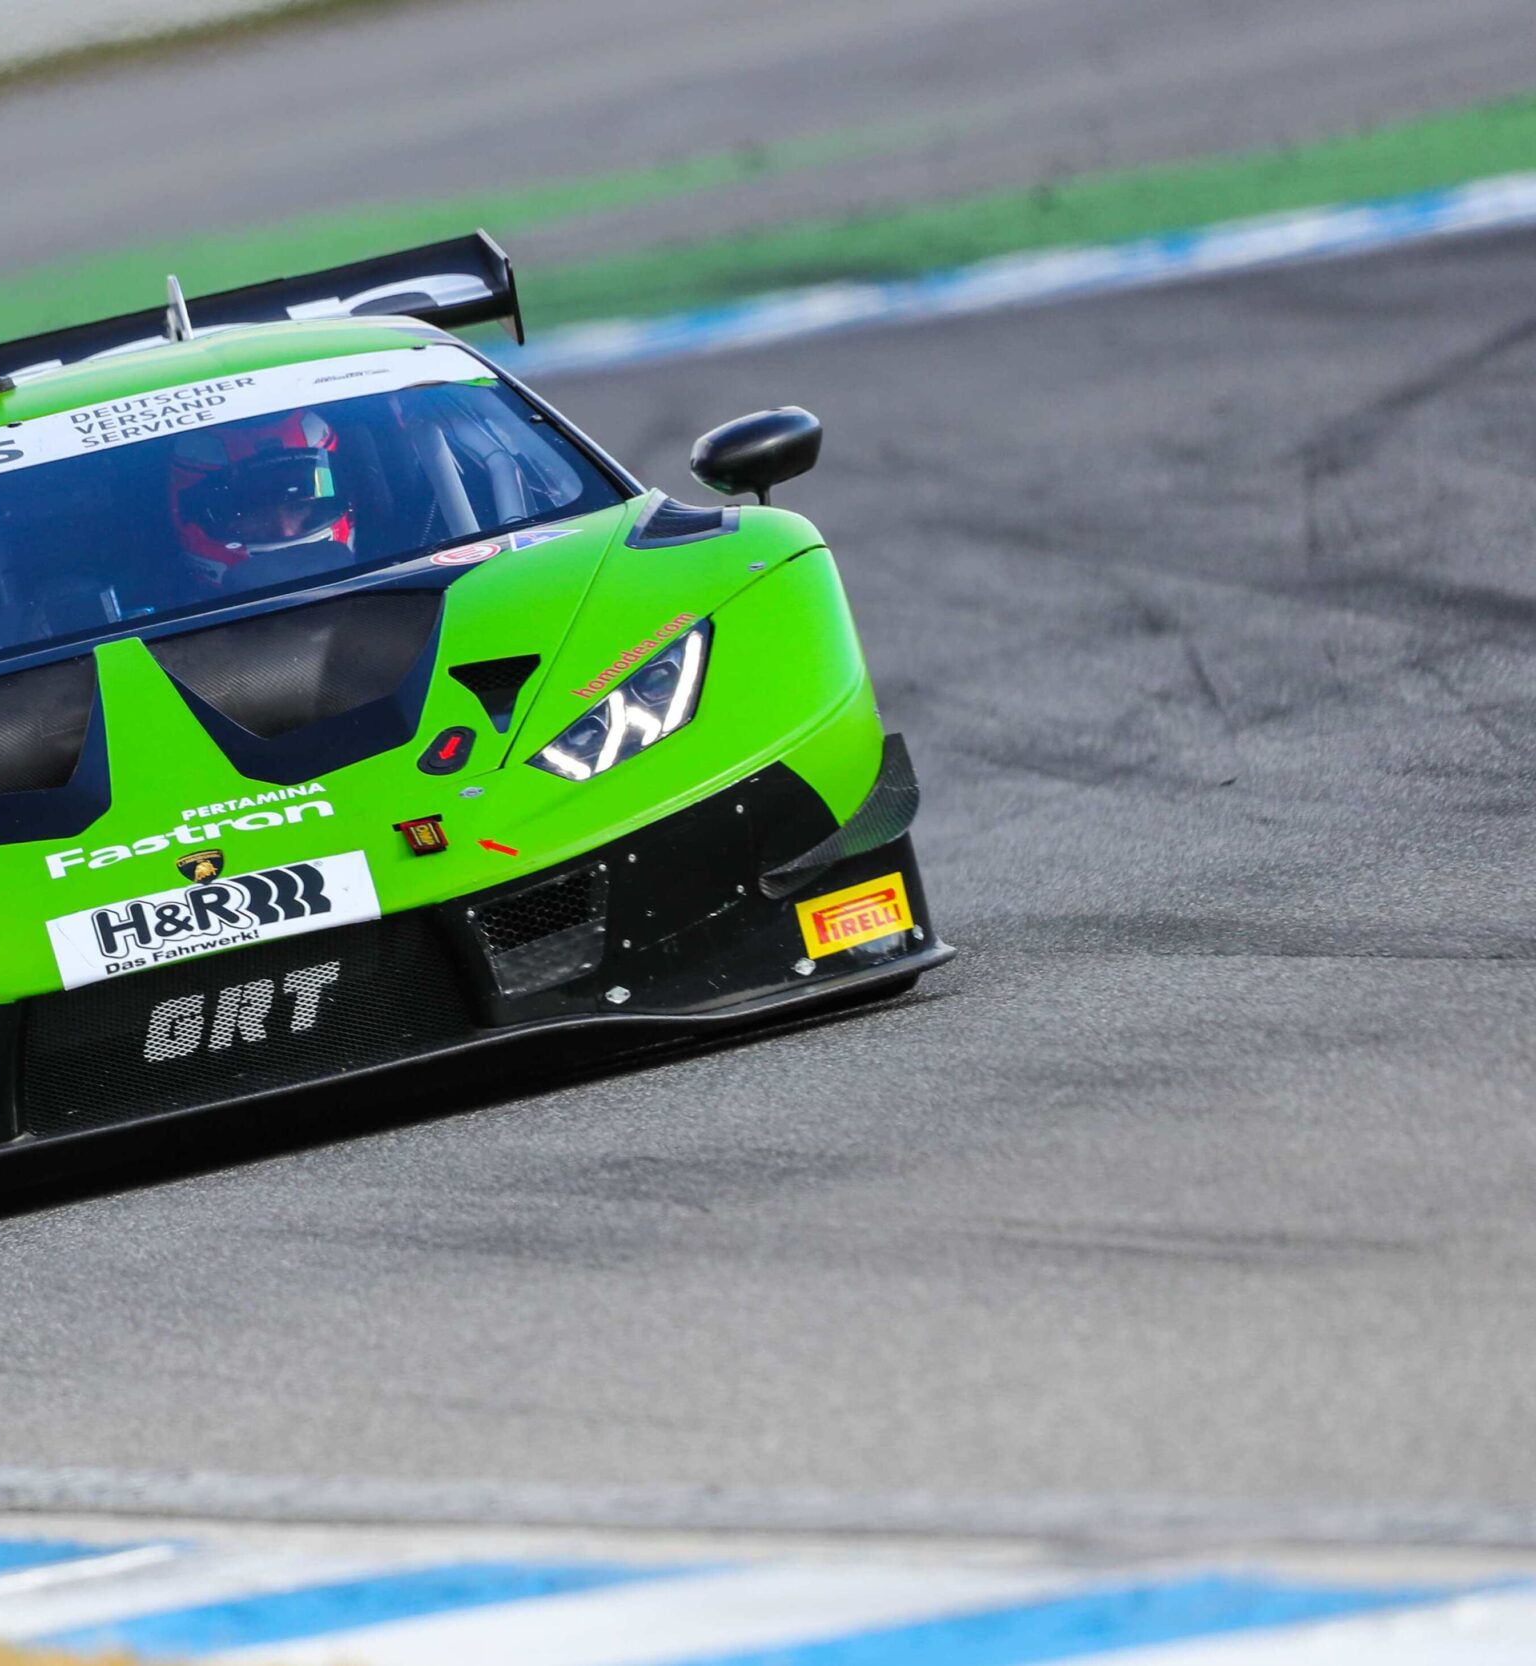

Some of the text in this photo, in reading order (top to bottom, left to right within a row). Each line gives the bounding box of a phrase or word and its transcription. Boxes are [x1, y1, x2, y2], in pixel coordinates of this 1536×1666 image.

[70, 376, 256, 424] DEUTSCHER
[75, 395, 227, 435] VERSAND
[82, 410, 216, 449] SERVICE
[571, 611, 696, 698] homodea.com
[181, 782, 327, 821] PERTAMINA
[45, 799, 335, 880] Fastron
[92, 882, 256, 959] H&R
[811, 888, 902, 945] PIRELLI
[105, 928, 261, 975] Das Fahrwerk!
[143, 960, 342, 1063] GRT
